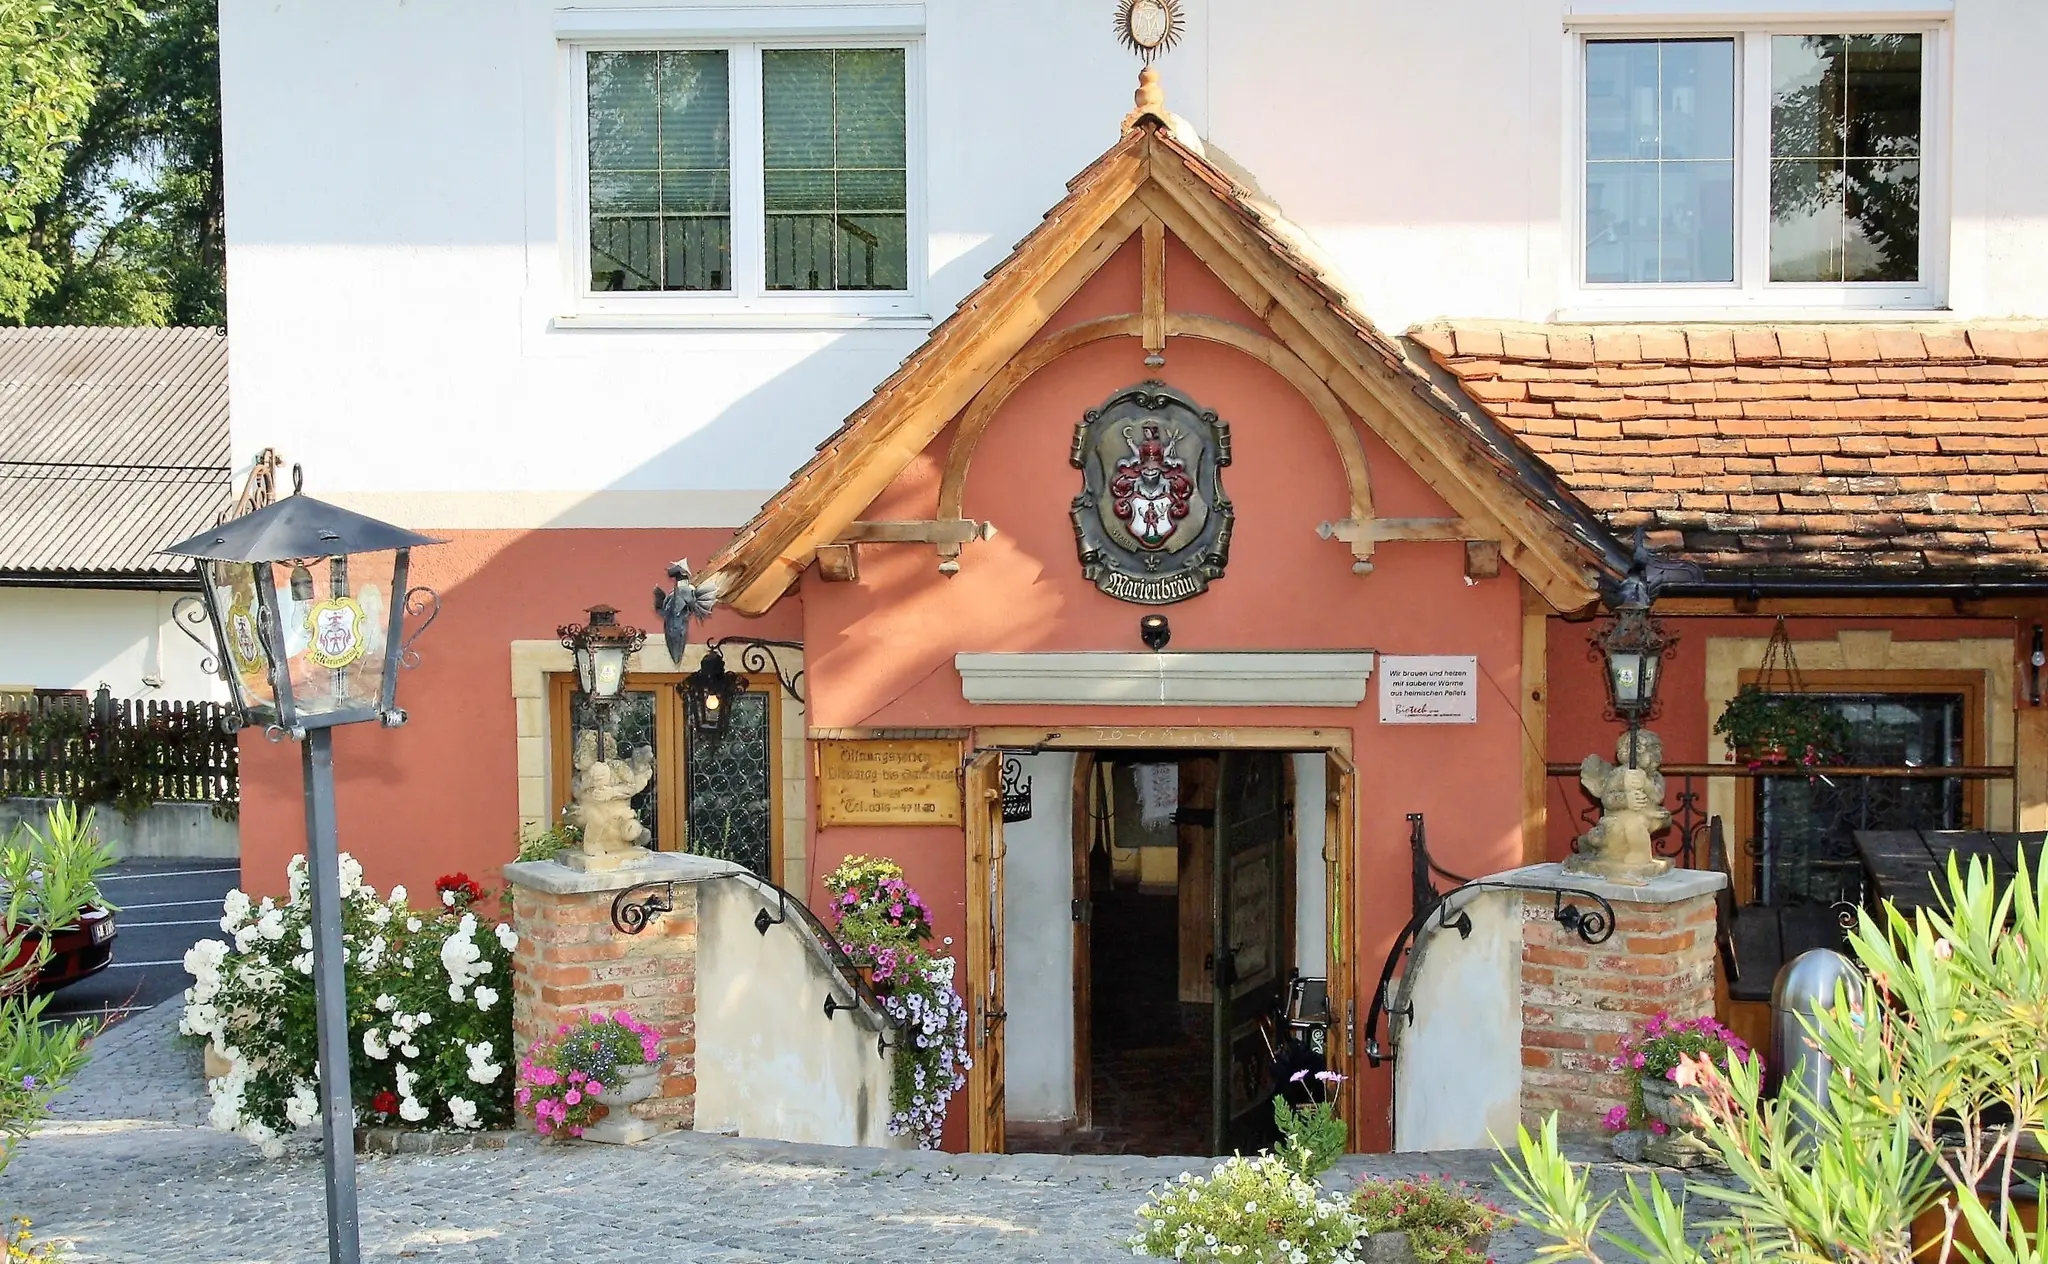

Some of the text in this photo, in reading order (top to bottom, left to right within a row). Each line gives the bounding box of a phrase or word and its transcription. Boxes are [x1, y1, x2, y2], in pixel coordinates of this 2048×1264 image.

[1106, 572, 1196, 600] Marienbräu
[1396, 703, 1427, 714] Biotech
[882, 768, 899, 780] bis
